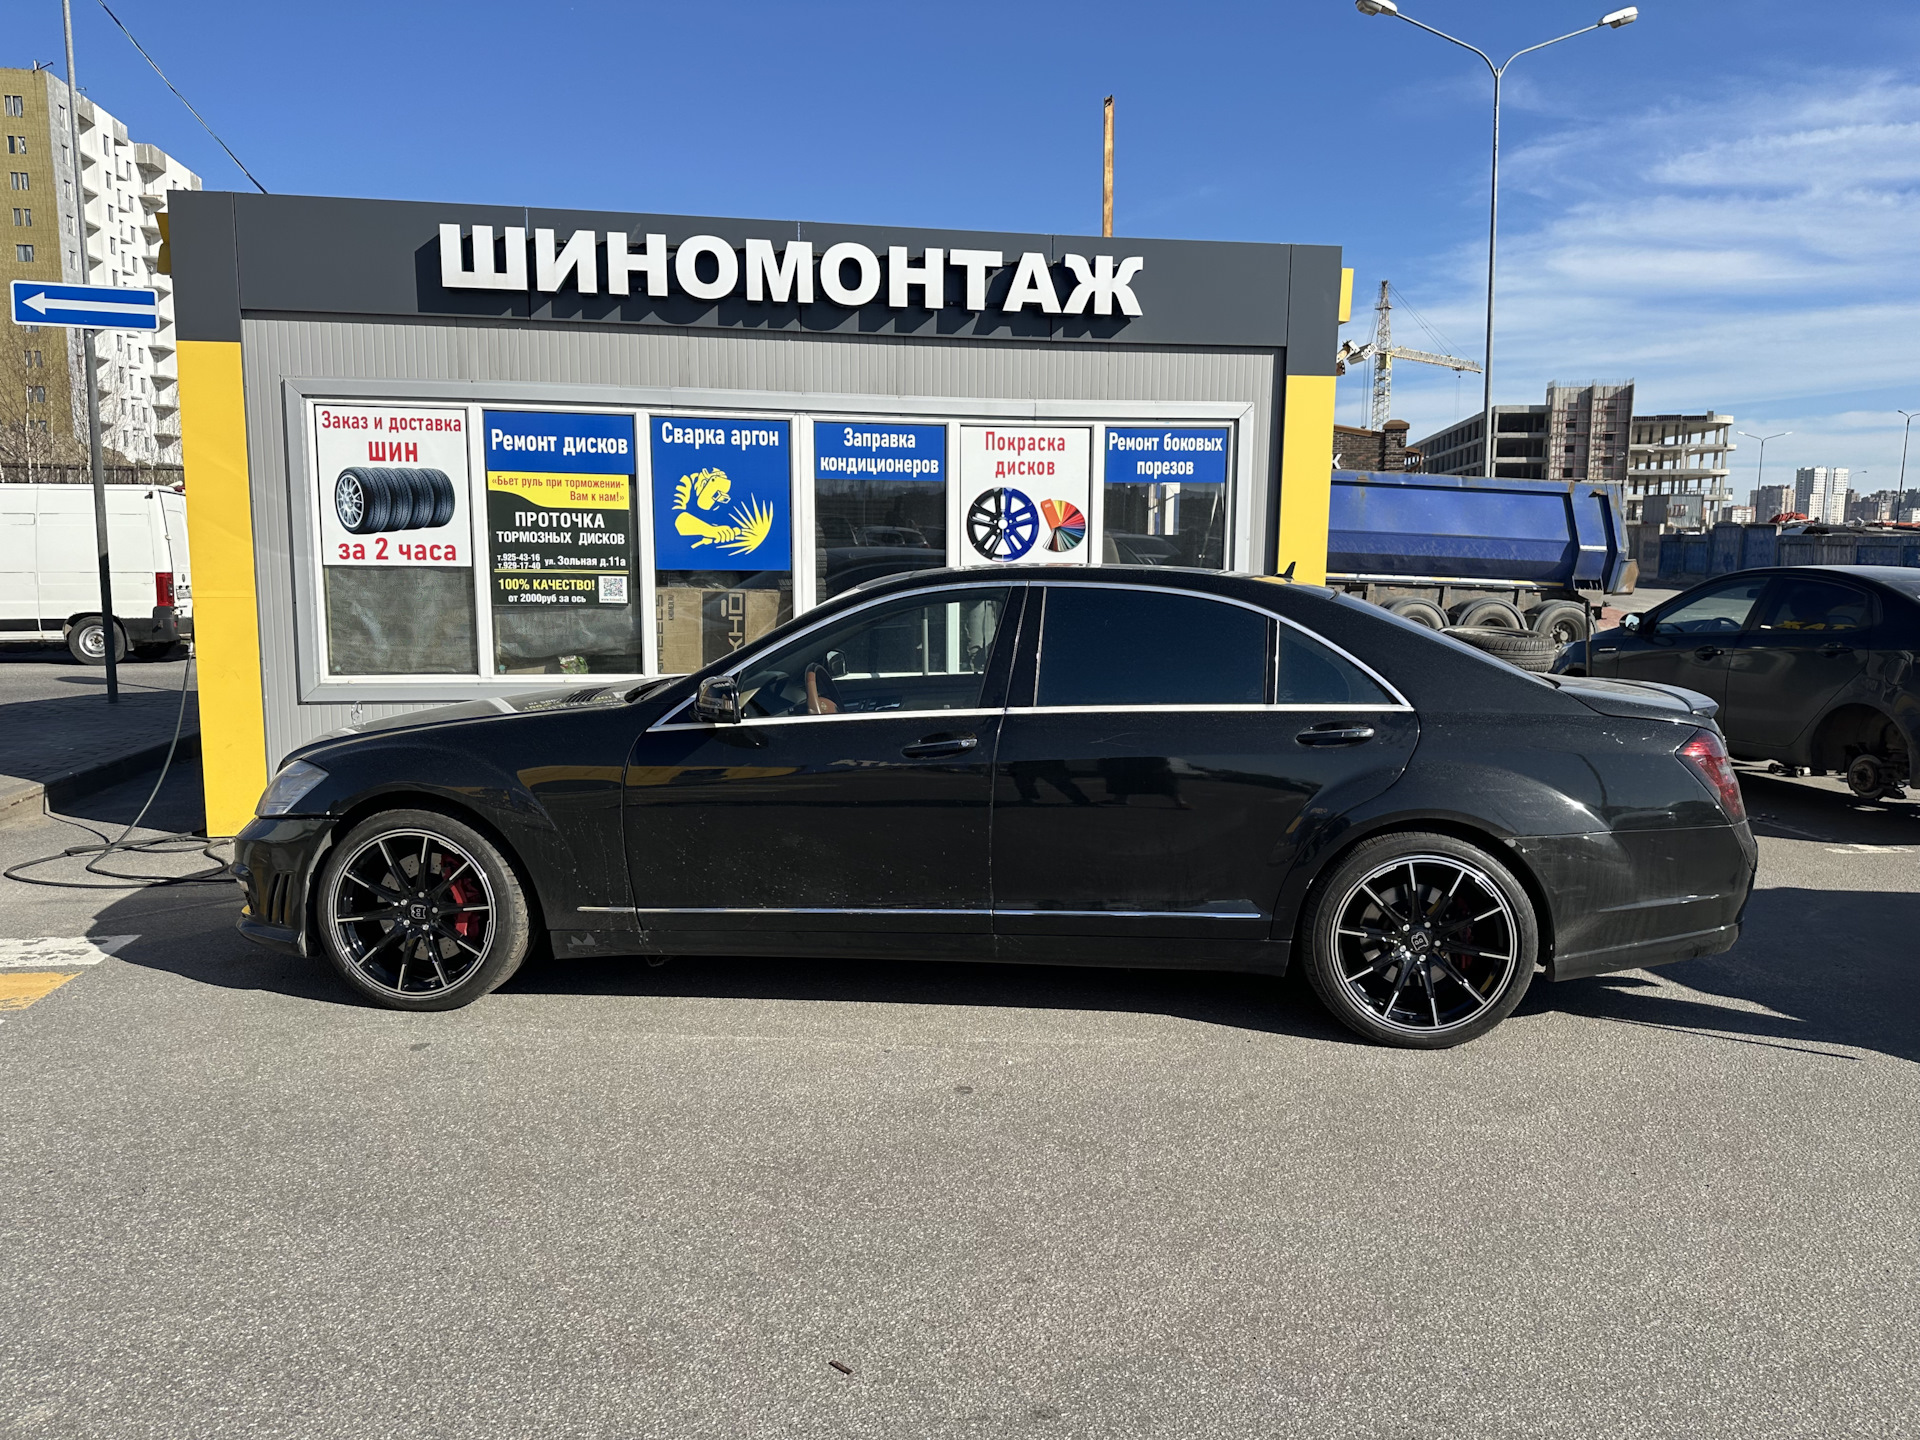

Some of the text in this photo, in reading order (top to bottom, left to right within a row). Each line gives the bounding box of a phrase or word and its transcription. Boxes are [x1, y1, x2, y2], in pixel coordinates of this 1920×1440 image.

[439, 223, 1144, 316] ШИНОМОНТАЖ
[322, 410, 462, 433] Заказ и доставка
[491, 428, 628, 456] Ремонт дисков
[661, 421, 779, 451] Сварка аргон
[843, 427, 916, 453] Заправка
[985, 431, 1065, 455] Покраска
[1108, 432, 1223, 452] Ремонт боковых
[368, 441, 418, 462] ШИН
[820, 456, 939, 478] кондиционеров
[995, 461, 1055, 478] дисков
[1136, 461, 1194, 480] порезов
[521, 478, 543, 489] руль
[545, 479, 562, 489] при
[570, 490, 589, 501] Вам
[591, 492, 597, 501] к
[515, 511, 605, 529] ПРОТОЧКА
[495, 530, 626, 546] ТОРМОЗНЫХ ДИСКОВ
[338, 537, 457, 561] за 2 часа
[544, 555, 626, 568] ул. Зольная д.11а
[499, 578, 595, 591] 100% КАЧЕСТВО!
[508, 593, 587, 605] от 2000руб за ось
